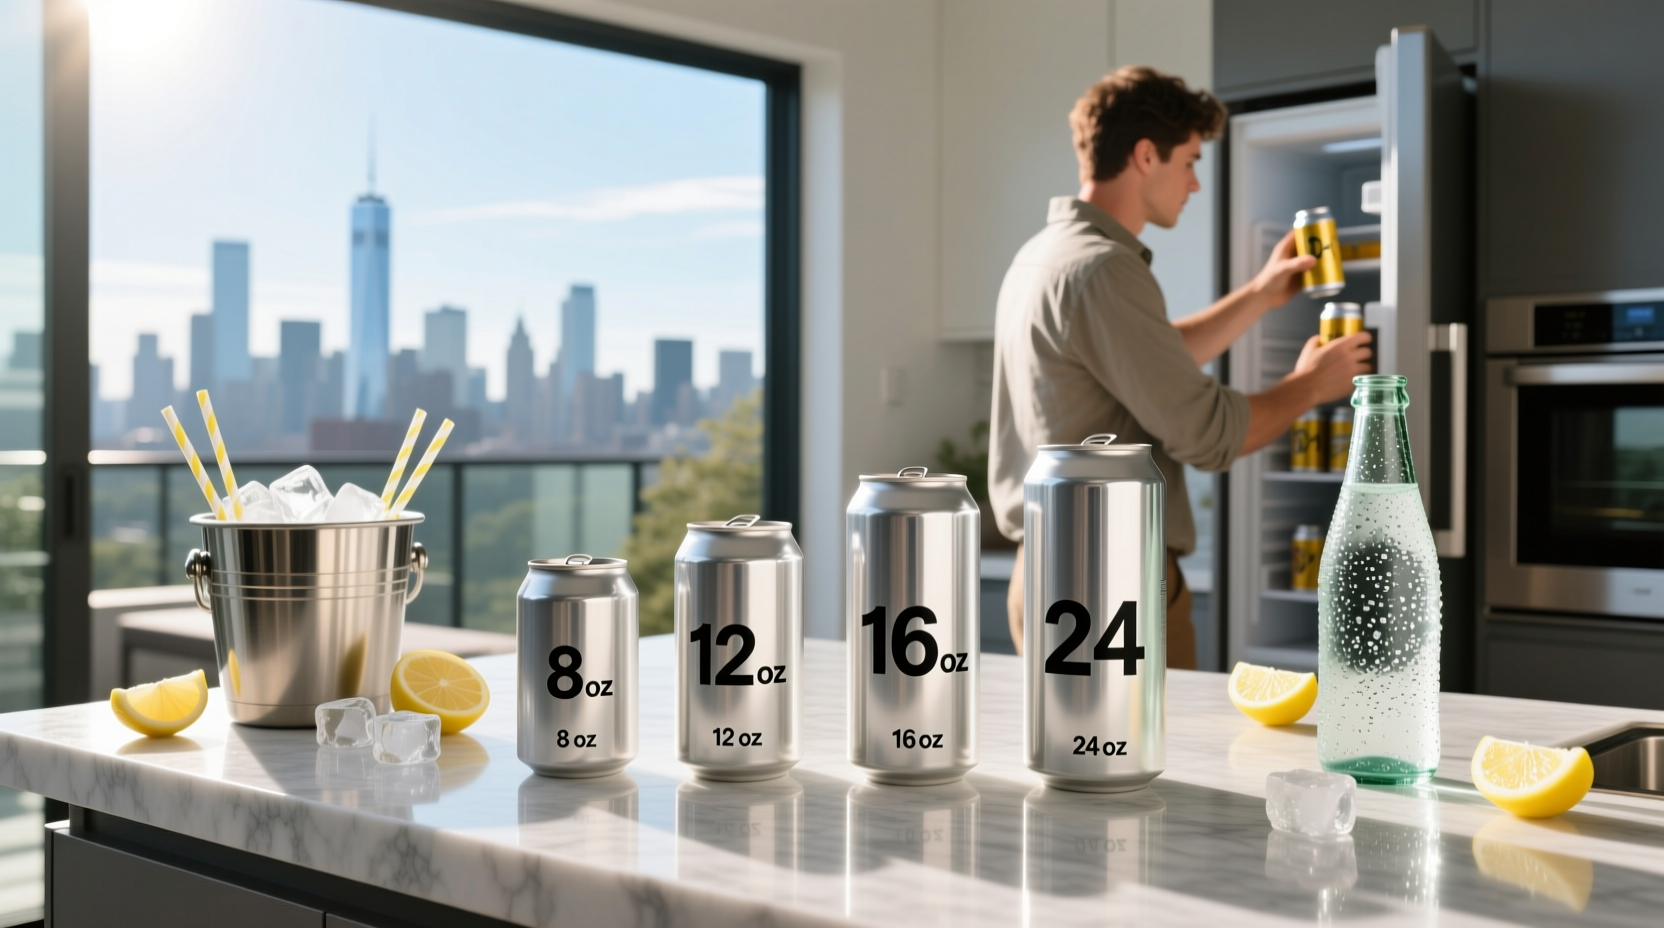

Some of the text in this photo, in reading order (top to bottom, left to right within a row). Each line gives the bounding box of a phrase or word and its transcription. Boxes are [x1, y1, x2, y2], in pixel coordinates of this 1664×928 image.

[1044, 599, 1146, 677] 24
[556, 729, 597, 748] 8 oz
[712, 727, 763, 747] 12 oz
[892, 728, 944, 749] 16 oz
[1072, 735, 1127, 756] 24 oz
